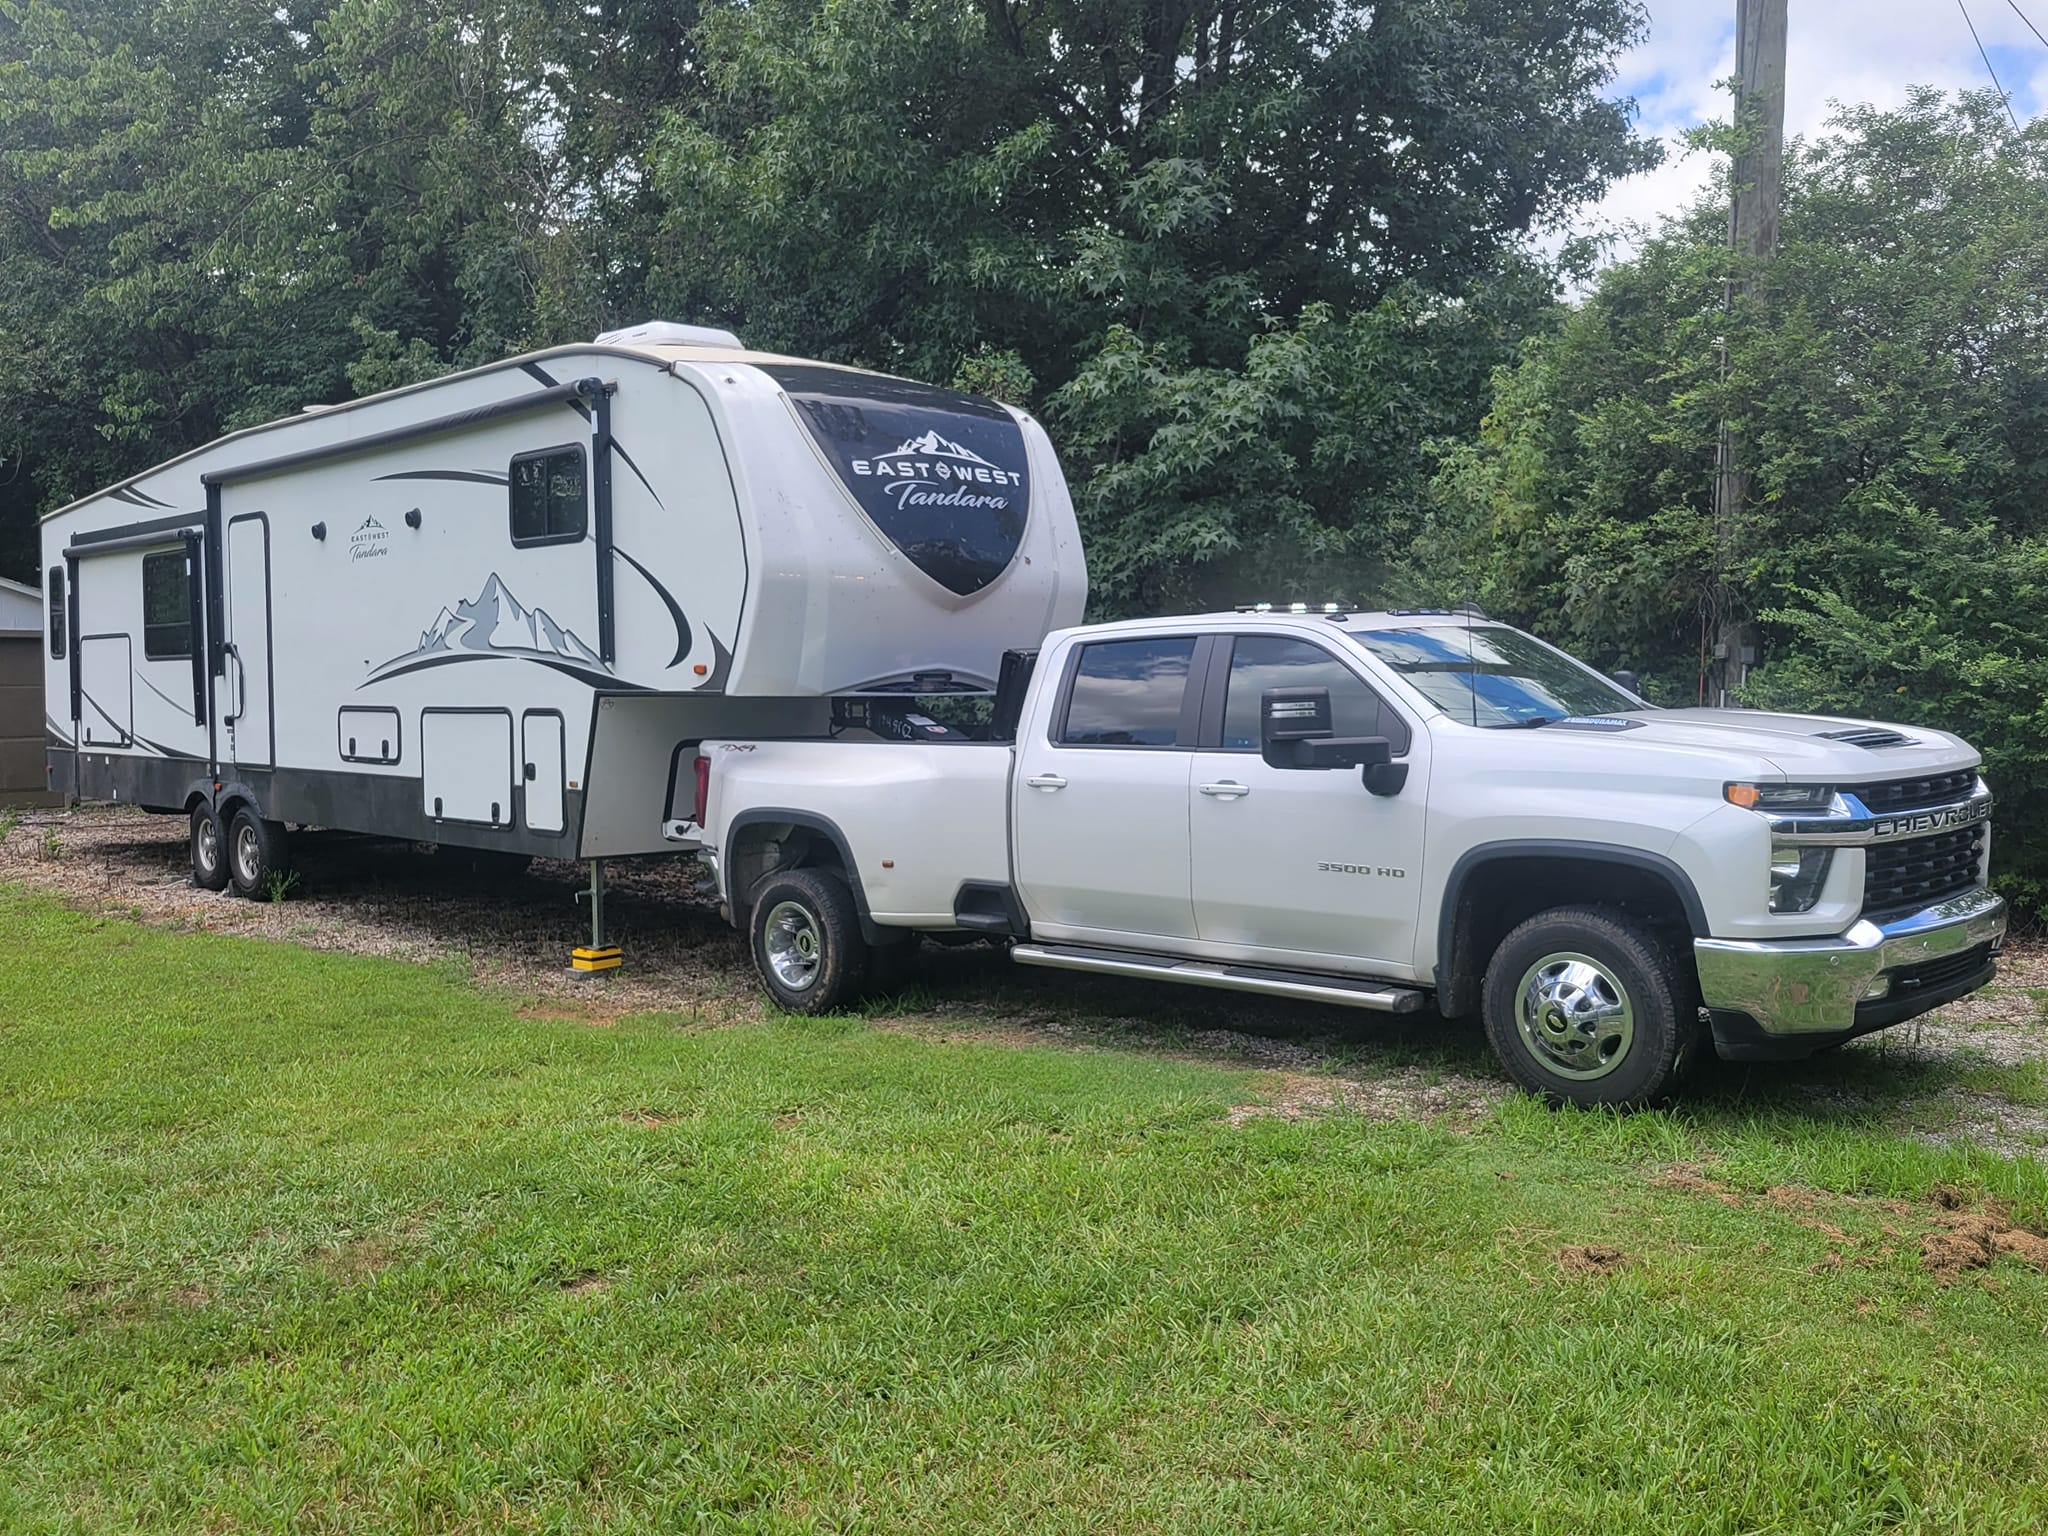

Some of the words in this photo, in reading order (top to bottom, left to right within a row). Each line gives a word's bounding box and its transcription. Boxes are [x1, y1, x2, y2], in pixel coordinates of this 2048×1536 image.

[851, 460, 930, 478] EAST
[952, 463, 1021, 486] WEST
[884, 480, 1008, 510] Tandara
[351, 534, 368, 543] EAST
[349, 543, 388, 563] Tandara
[1874, 801, 1991, 837] CHEVROLET
[1317, 861, 1370, 875] 3500
[1377, 866, 1405, 878] HD
